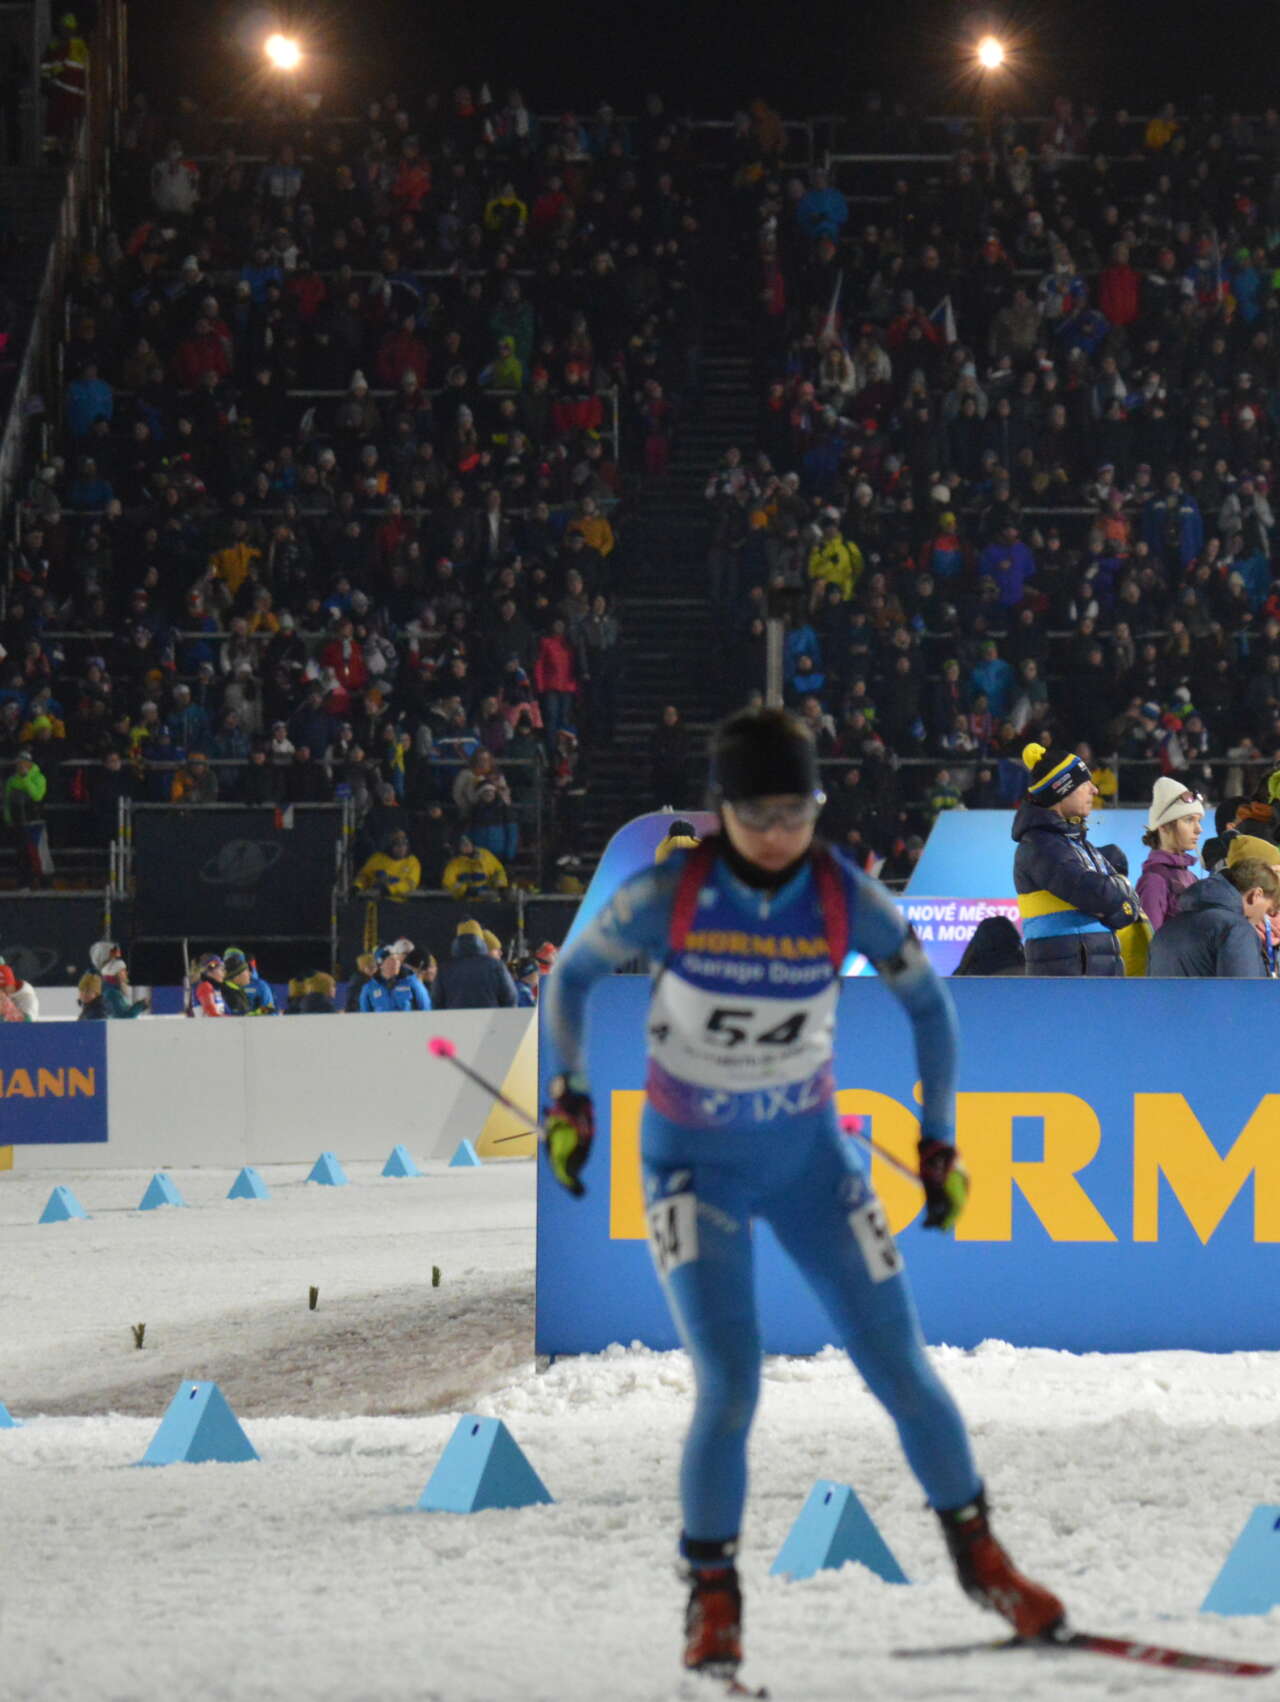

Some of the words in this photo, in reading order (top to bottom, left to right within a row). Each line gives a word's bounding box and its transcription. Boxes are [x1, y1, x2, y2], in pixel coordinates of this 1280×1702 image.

[908, 903, 955, 921] NOVÉ
[707, 1008, 807, 1047] 54
[0, 1067, 95, 1098] ANN
